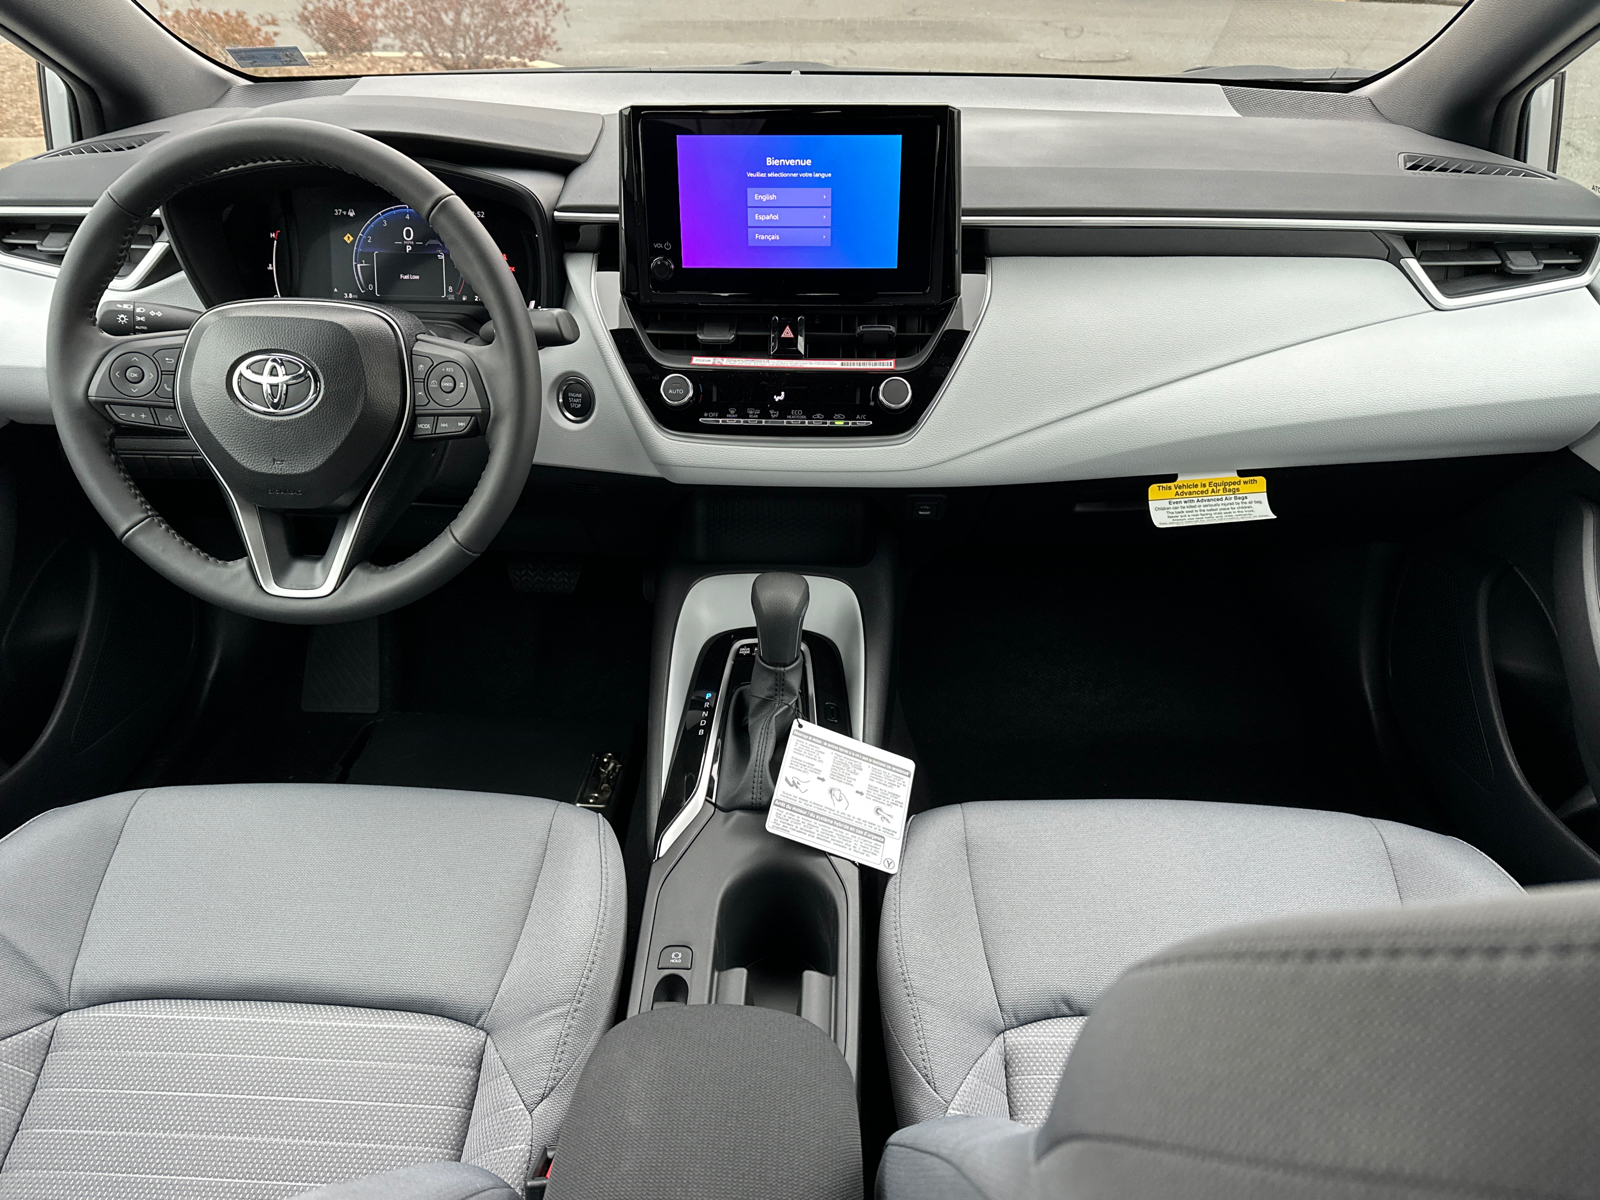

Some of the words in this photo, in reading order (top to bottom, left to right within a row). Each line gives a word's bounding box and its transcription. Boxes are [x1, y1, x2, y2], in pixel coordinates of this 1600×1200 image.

[766, 156, 812, 166] Bienvenue
[754, 194, 777, 202] English
[755, 214, 780, 222] Español
[402, 226, 414, 241] 0
[756, 234, 780, 242] Français
[406, 245, 412, 253] P
[1174, 482, 1198, 490] Vehicle
[1208, 480, 1242, 488] Equipped
[1174, 488, 1208, 497] Advanced
[886, 860, 892, 868] Y
